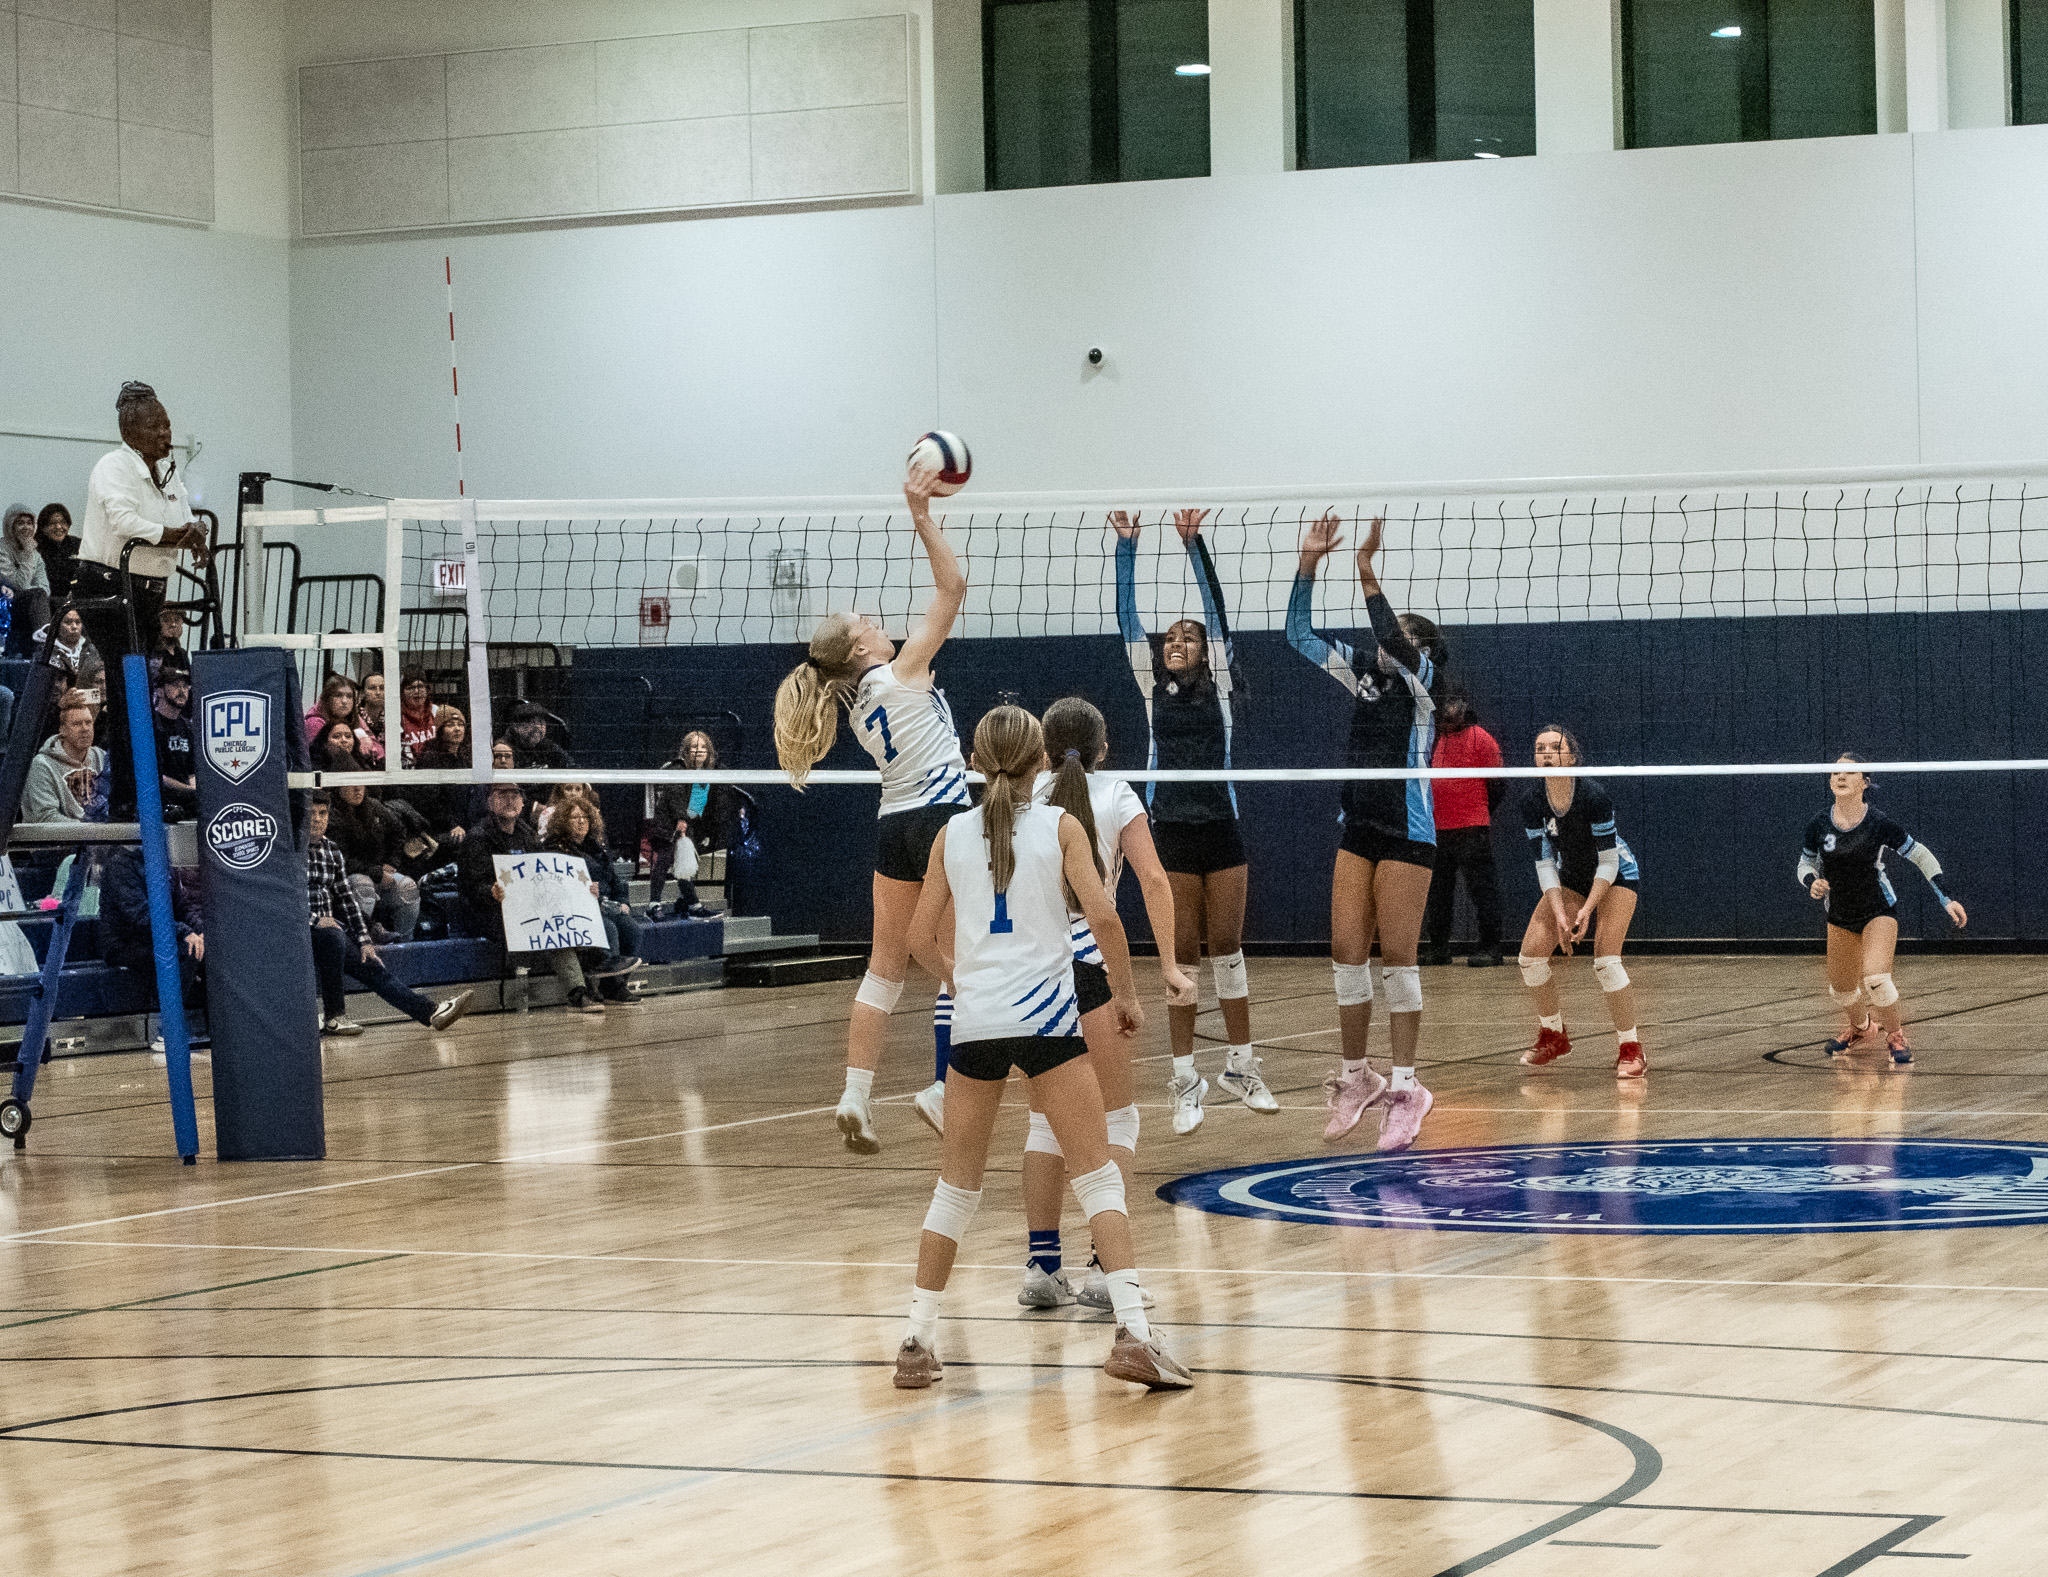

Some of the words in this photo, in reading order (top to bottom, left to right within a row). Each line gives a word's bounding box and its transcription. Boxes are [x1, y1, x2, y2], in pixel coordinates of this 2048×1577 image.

[440, 563, 466, 586] EXIT
[210, 701, 261, 738] CPL
[223, 740, 247, 748] CHICAGO
[865, 704, 899, 764] 7
[211, 818, 272, 845] SCORE!
[1823, 833, 1837, 852] 3
[512, 857, 575, 879] TALK
[542, 916, 577, 933] APC
[529, 930, 593, 950] HANDS
